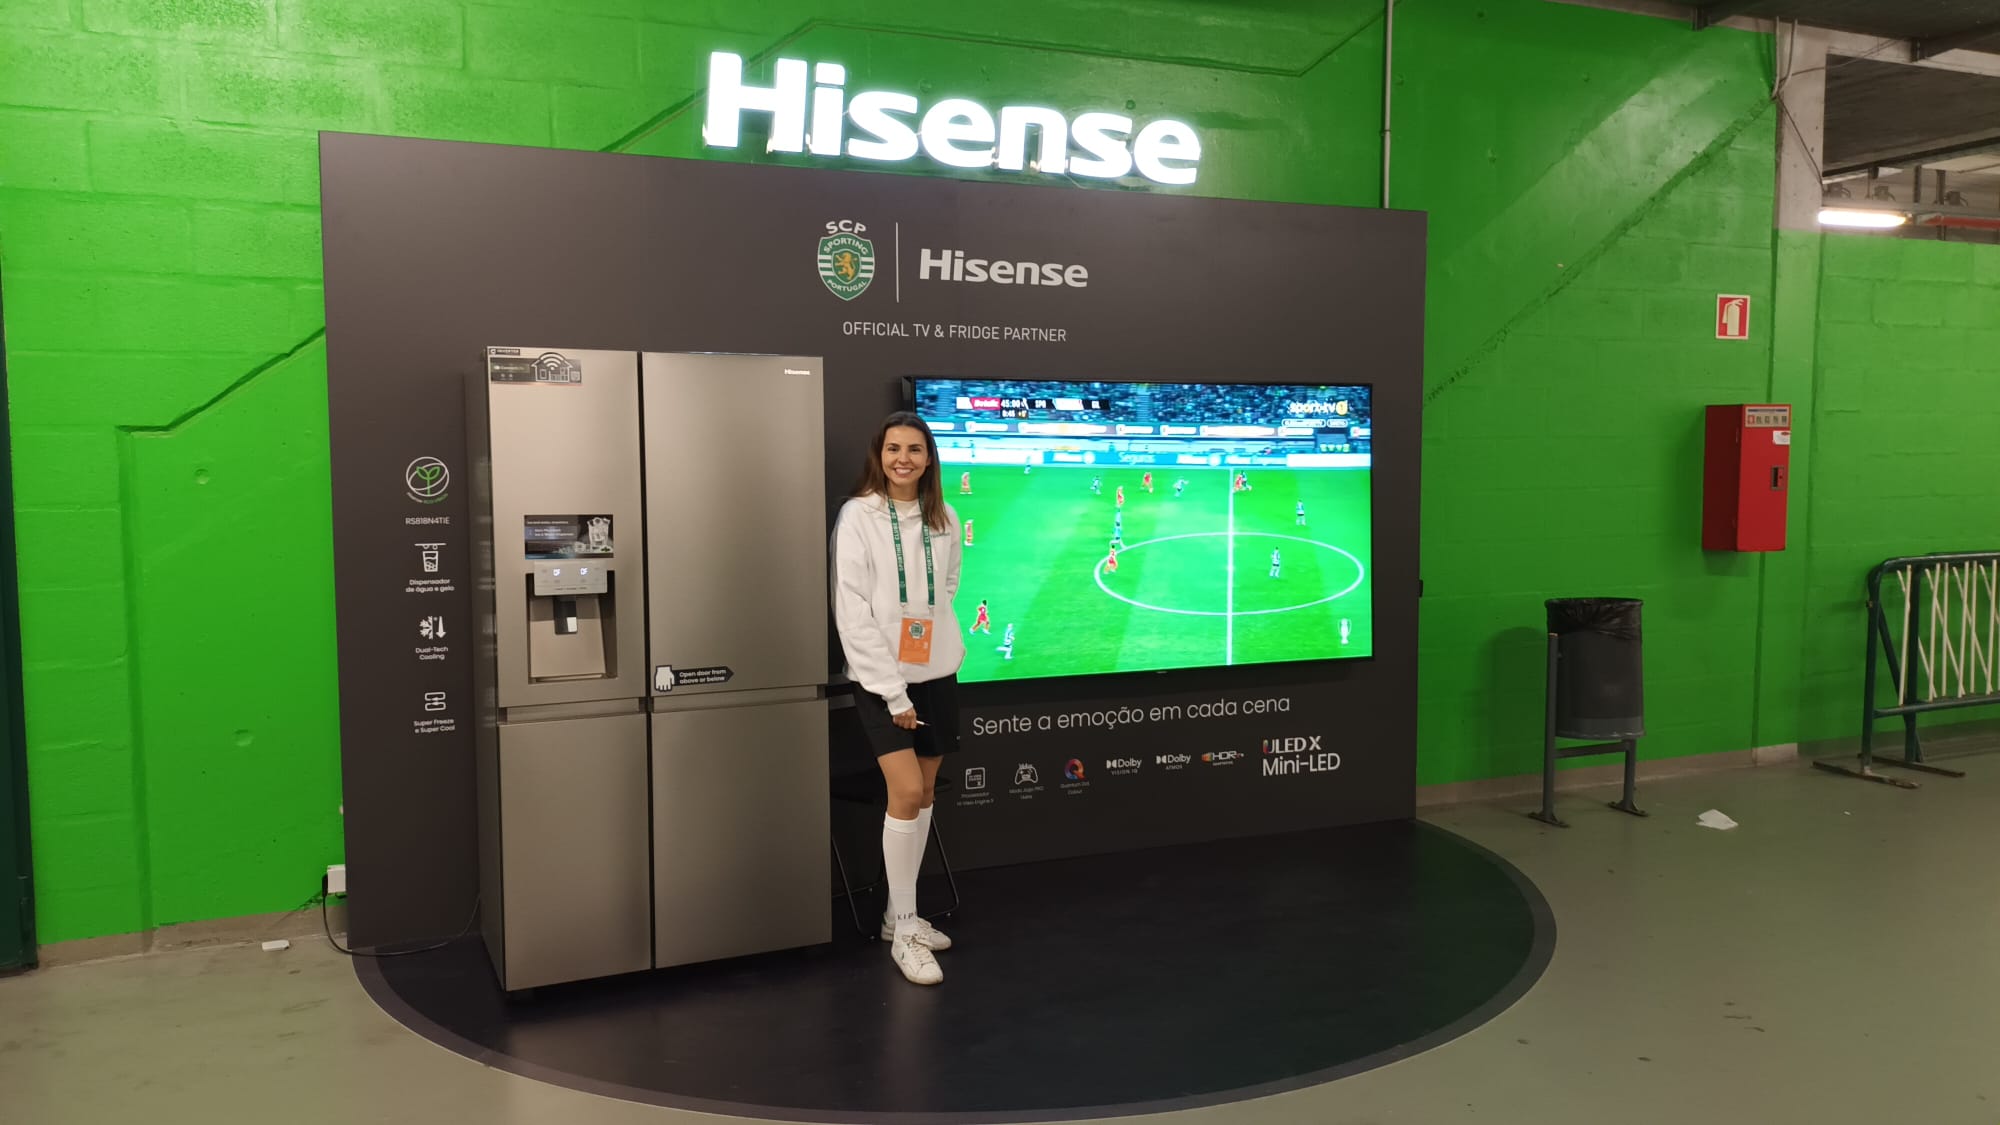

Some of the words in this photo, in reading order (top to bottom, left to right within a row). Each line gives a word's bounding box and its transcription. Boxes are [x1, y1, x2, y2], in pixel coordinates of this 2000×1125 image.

[705, 51, 1201, 185] Hisense
[825, 219, 867, 234] SCP
[824, 237, 869, 255] SPORTING
[919, 248, 1089, 288] Hisense
[827, 279, 867, 291] PORTUGAL
[842, 321, 909, 337] OFFICIAL
[912, 323, 930, 337] TV
[934, 324, 944, 338] &
[949, 325, 1000, 340] FRIDGE
[1004, 326, 1066, 341] PARTNER
[409, 578, 450, 586] Dispensador
[972, 715, 1032, 736] Sente
[1037, 714, 1051, 730] a
[1057, 706, 1144, 730] emoção
[1150, 703, 1181, 721] em
[1187, 698, 1237, 719] cada
[1242, 697, 1290, 714] cena
[1263, 737, 1307, 754] ULED
[1309, 735, 1321, 751] X
[1117, 758, 1142, 769] Dolby
[1167, 753, 1192, 764] Dolby
[1262, 752, 1341, 777] Mini-LED
